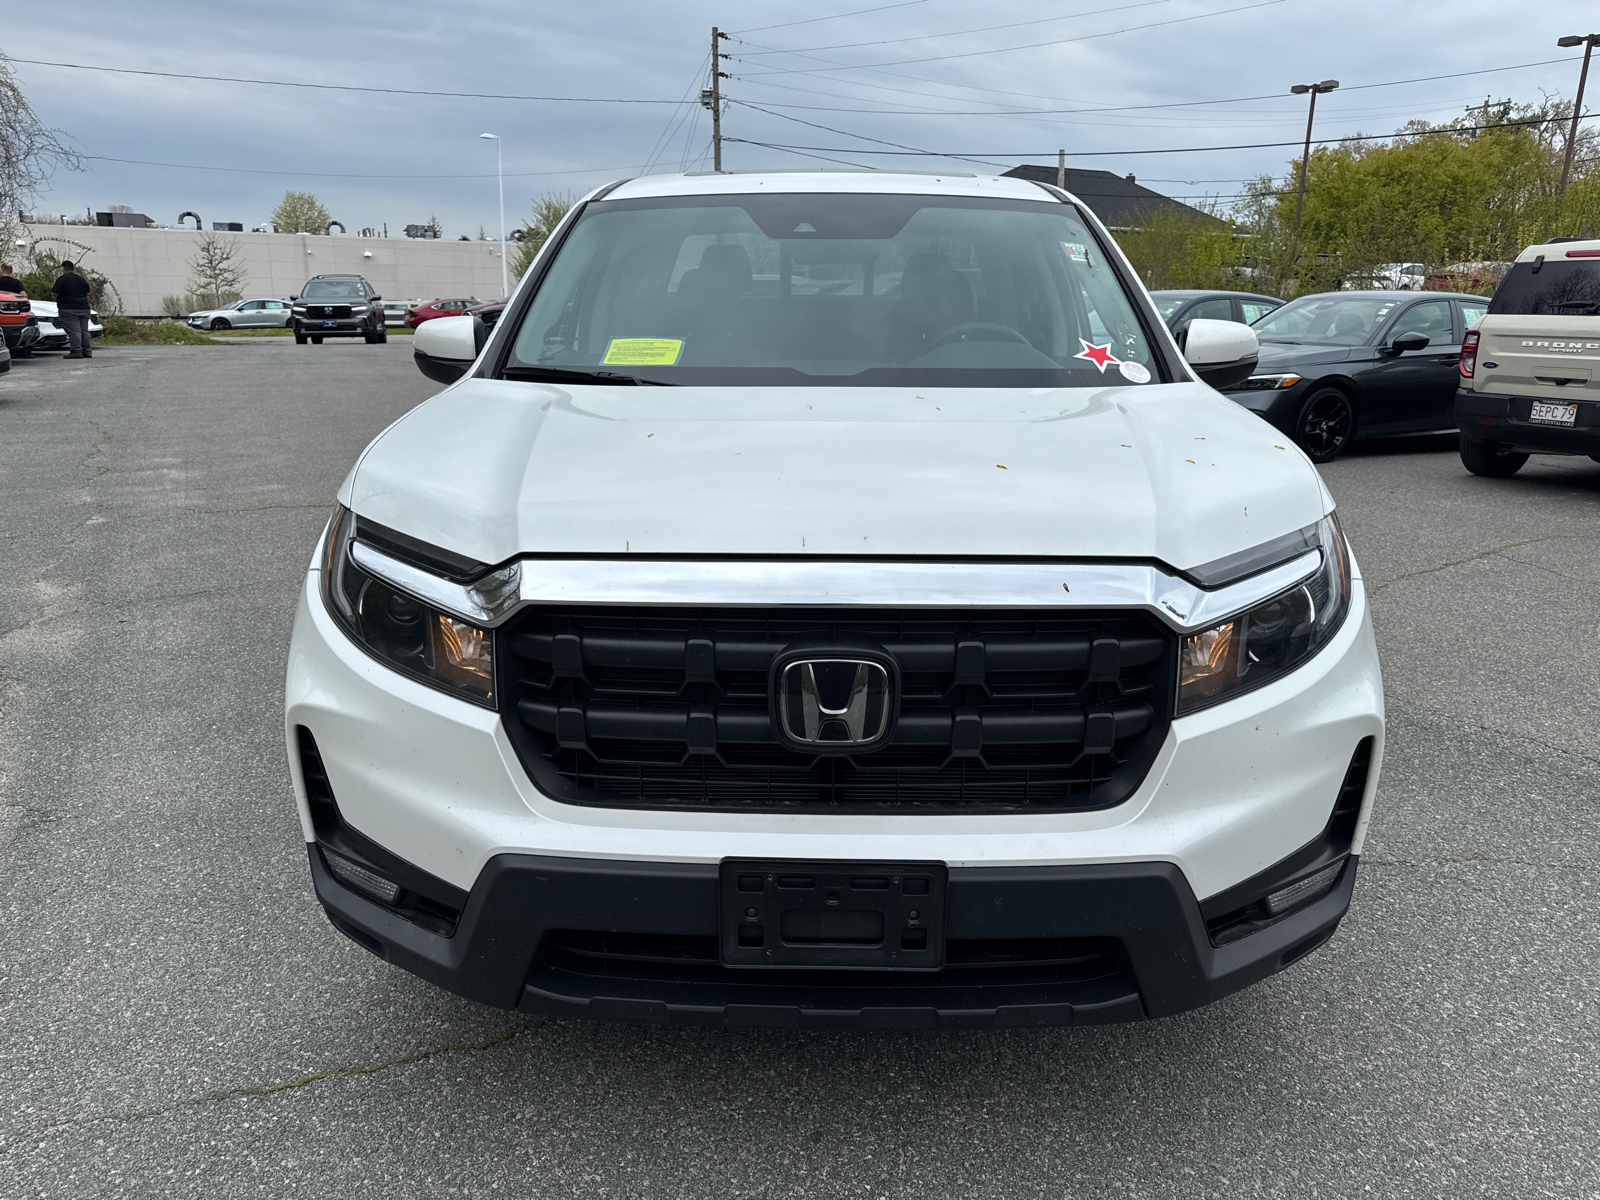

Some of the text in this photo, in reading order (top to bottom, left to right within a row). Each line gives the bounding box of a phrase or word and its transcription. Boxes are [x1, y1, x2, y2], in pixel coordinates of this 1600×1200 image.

[1521, 341, 1600, 349] BRONC
[1532, 405, 1575, 419] 5EPC 79
